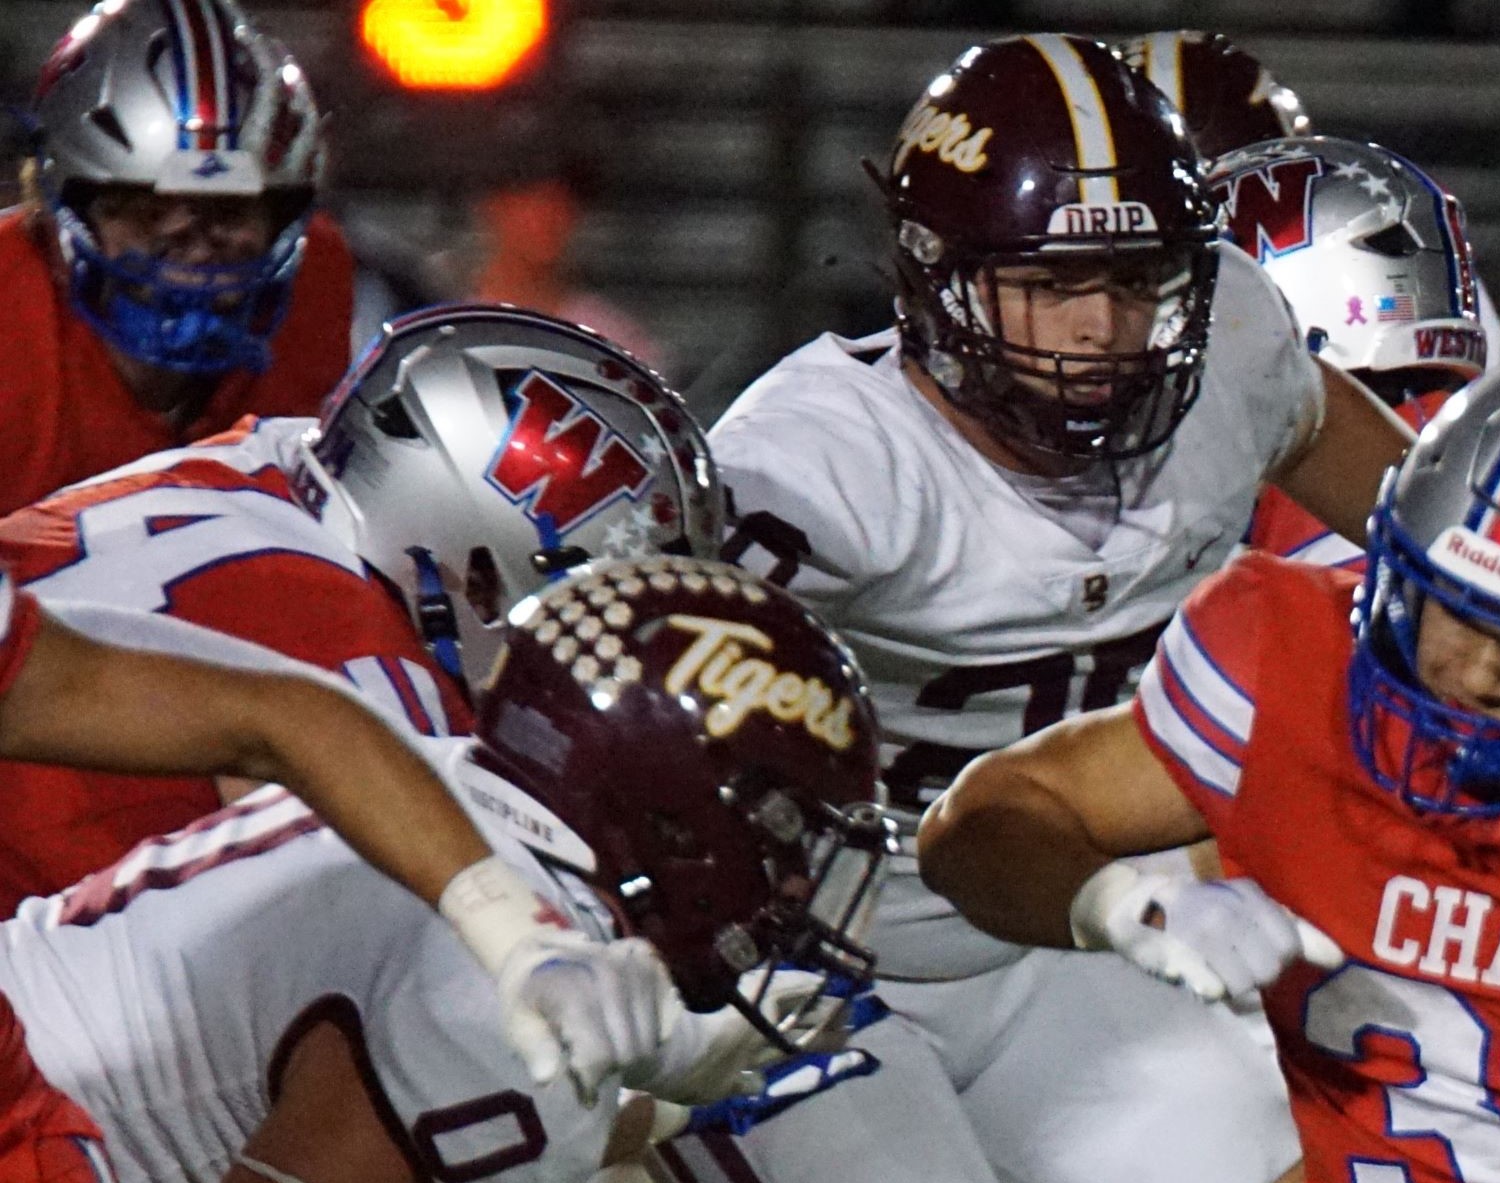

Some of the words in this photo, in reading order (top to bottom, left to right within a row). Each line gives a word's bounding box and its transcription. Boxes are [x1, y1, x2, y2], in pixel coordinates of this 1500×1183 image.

[893, 98, 993, 173] gers
[1063, 206, 1147, 236] DRIP
[1212, 155, 1324, 265] W
[484, 366, 656, 538] W
[634, 613, 858, 750] Tigers
